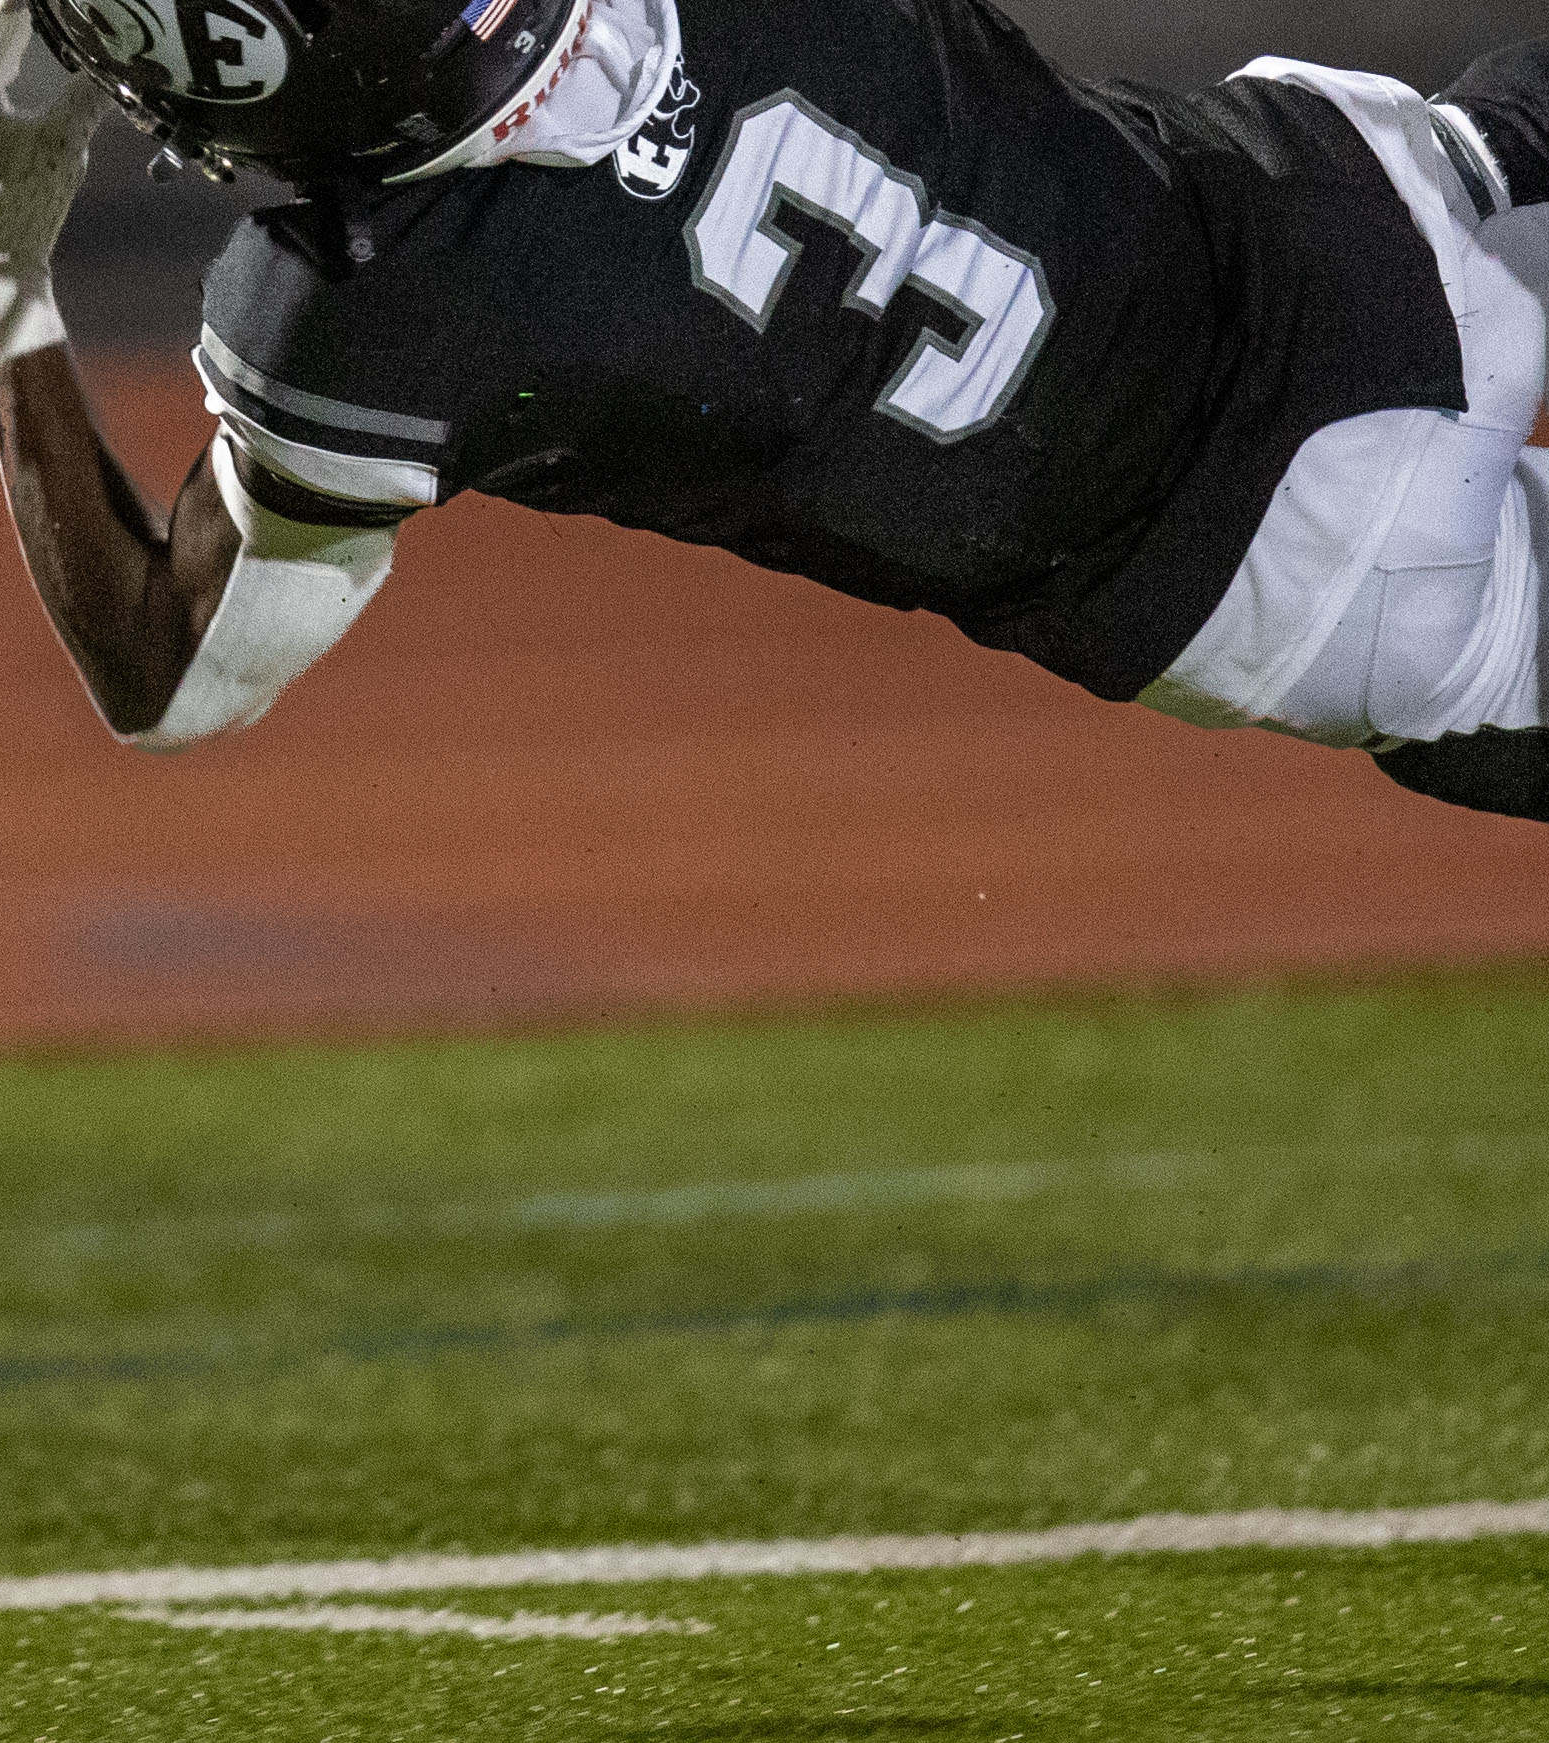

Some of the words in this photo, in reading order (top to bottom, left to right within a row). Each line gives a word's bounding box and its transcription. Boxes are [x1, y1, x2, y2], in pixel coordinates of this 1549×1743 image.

[514, 30, 537, 54] 3
[614, 134, 690, 191] E
[682, 87, 1057, 445] 3
